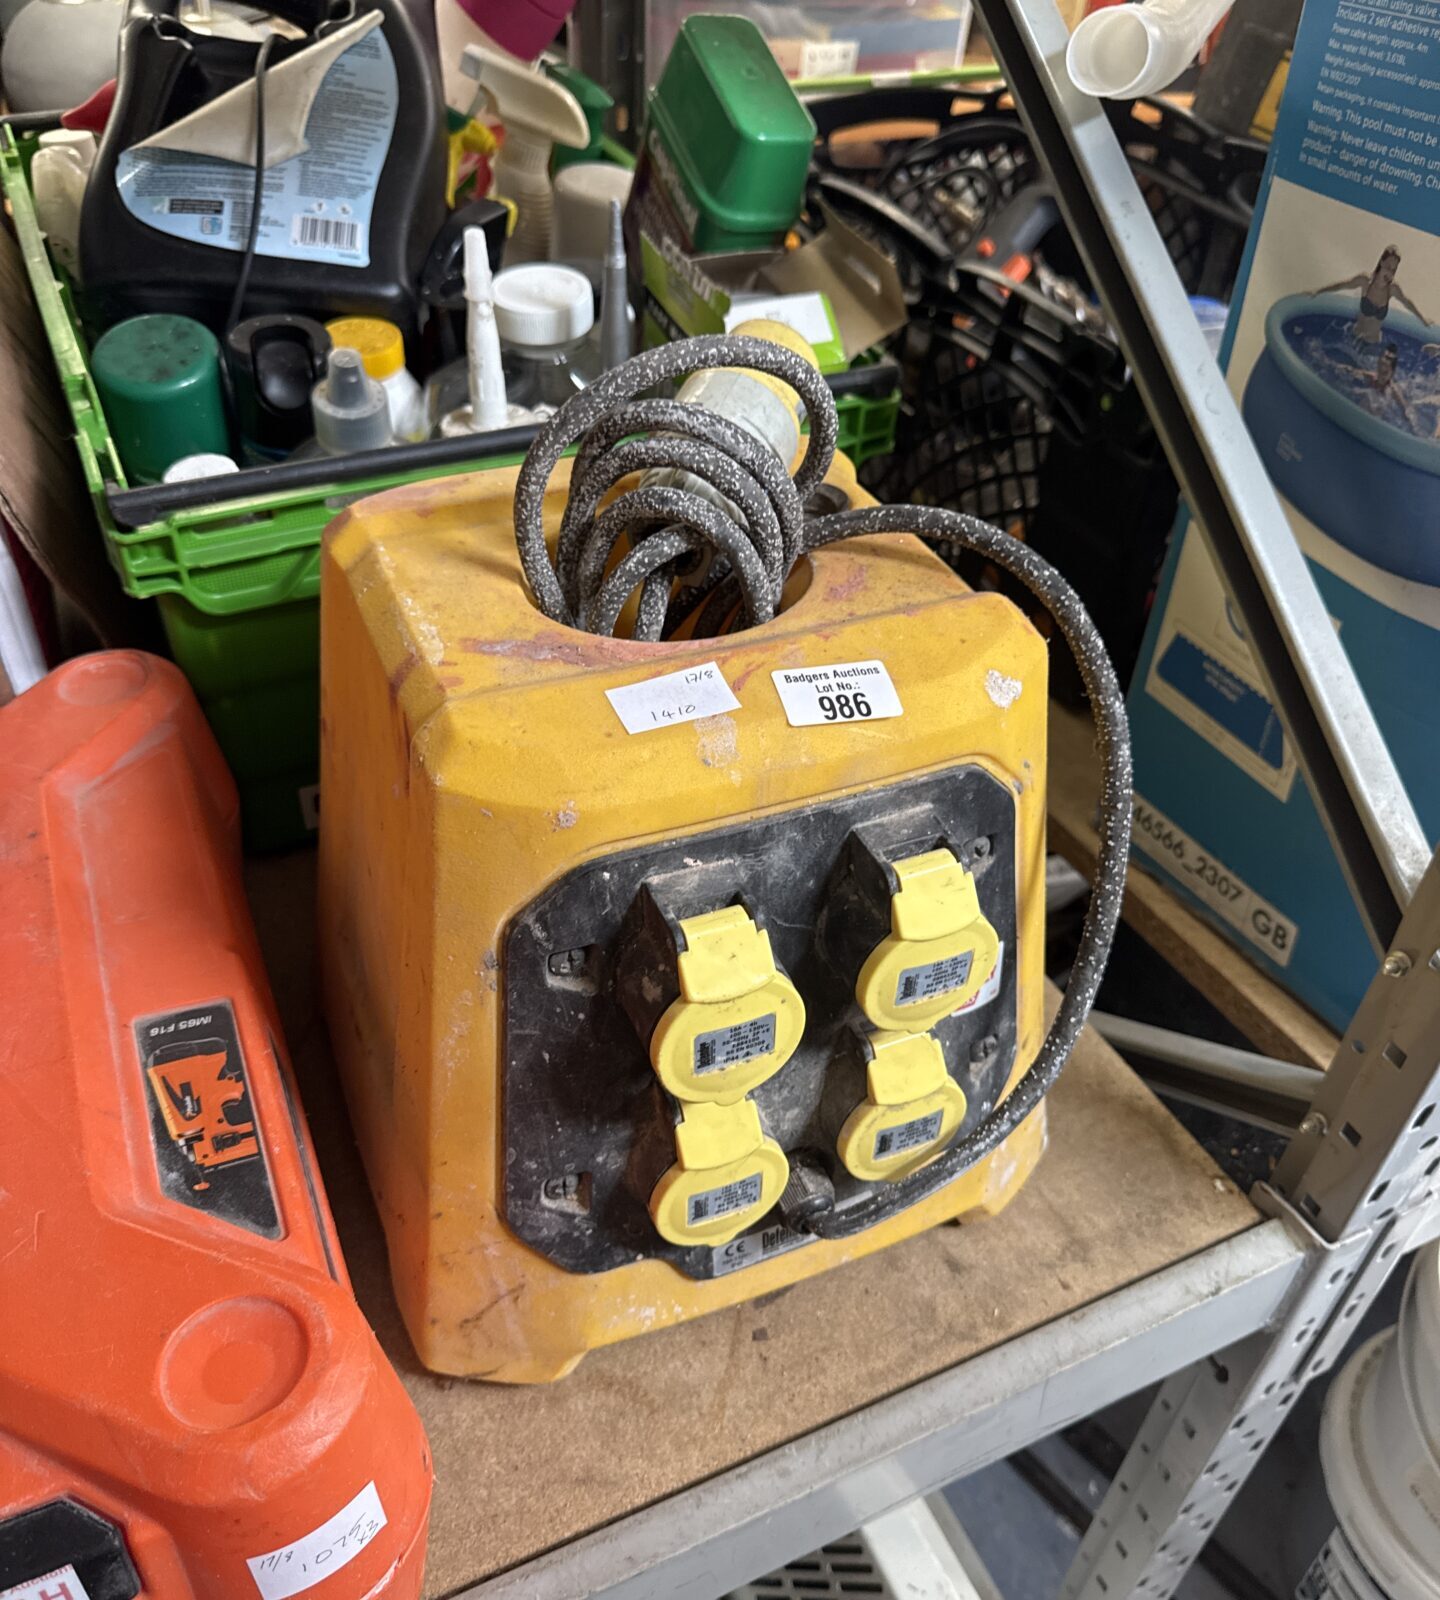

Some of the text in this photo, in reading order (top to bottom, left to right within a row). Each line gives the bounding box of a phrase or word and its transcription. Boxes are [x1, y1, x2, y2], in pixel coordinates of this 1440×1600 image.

[1390, 0, 1413, 14] using
[1414, 2, 1438, 18] valve
[1336, 6, 1440, 42] Includes 2 self-adhesive re
[1373, 99, 1401, 114] contains
[1402, 104, 1436, 123] important
[1345, 109, 1361, 125] This
[1362, 117, 1382, 133] pool
[1383, 123, 1406, 138] must
[1407, 130, 1424, 144] not
[1425, 131, 1438, 147] be
[1340, 129, 1364, 147] Never
[1364, 138, 1388, 156] leave
[1388, 146, 1426, 167] children
[1302, 137, 1332, 155] product
[1339, 148, 1367, 167] danger
[1368, 158, 1379, 170] of
[1379, 161, 1423, 187] drowning.
[1425, 174, 1440, 190] Ch
[1307, 155, 1327, 171] small
[1327, 163, 1362, 184] amounts
[1362, 173, 1373, 185] of
[1373, 179, 1399, 195] water.
[684, 669, 715, 684] 17/8
[784, 664, 881, 685] Badgers Auctions
[815, 680, 862, 694] Lot No.:
[818, 692, 873, 721] 986
[1251, 908, 1288, 950] GB
[150, 1015, 212, 1037] IM65 F16
[762, 1226, 794, 1249] Defen
[260, 1550, 294, 1572] 17/8
